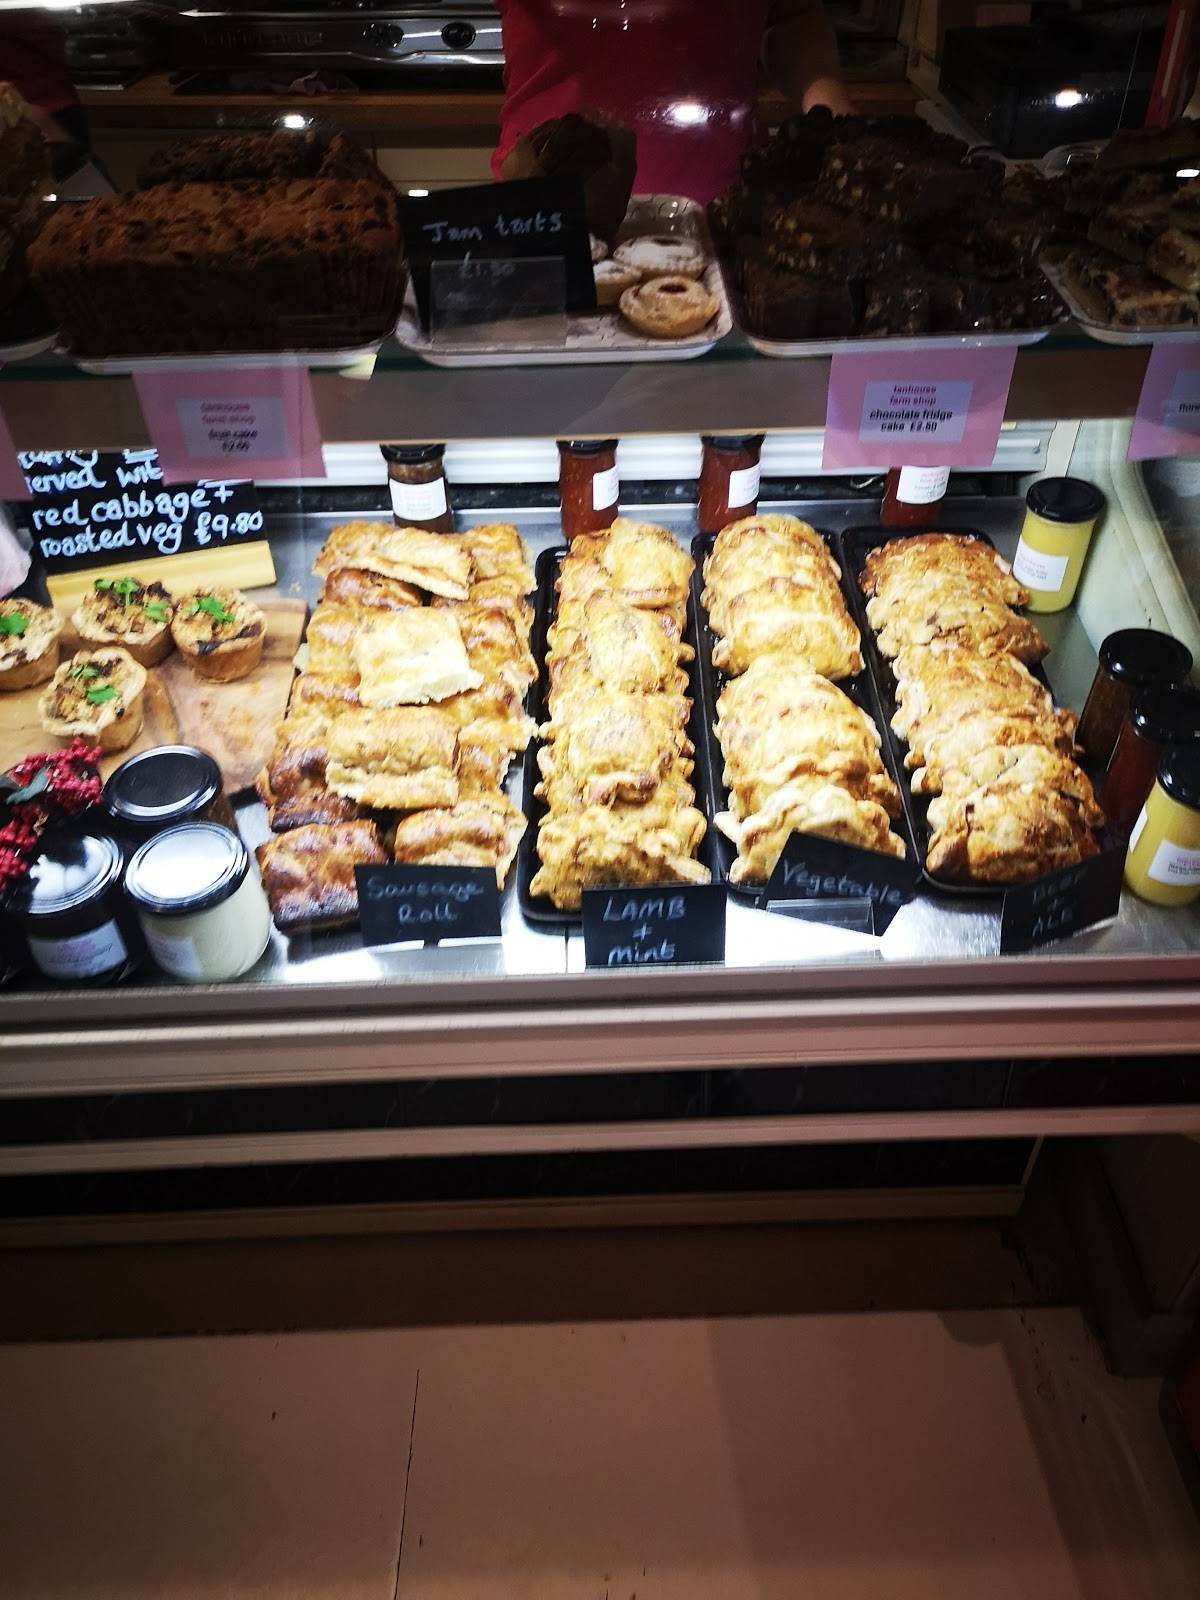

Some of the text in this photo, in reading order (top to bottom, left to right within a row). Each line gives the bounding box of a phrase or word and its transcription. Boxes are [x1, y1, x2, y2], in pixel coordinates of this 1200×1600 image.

[422, 211, 562, 243] Jam tarts
[869, 408, 953, 422] chocolate fridge
[880, 421, 905, 432] cake
[25, 464, 107, 494] erved
[32, 498, 89, 530] red
[91, 489, 211, 523] cabbage
[39, 510, 264, 558] roasted veg £9.80
[783, 858, 903, 904] Vegetable
[399, 903, 458, 923] Roll
[603, 896, 686, 922] LAMB
[632, 922, 653, 942] +
